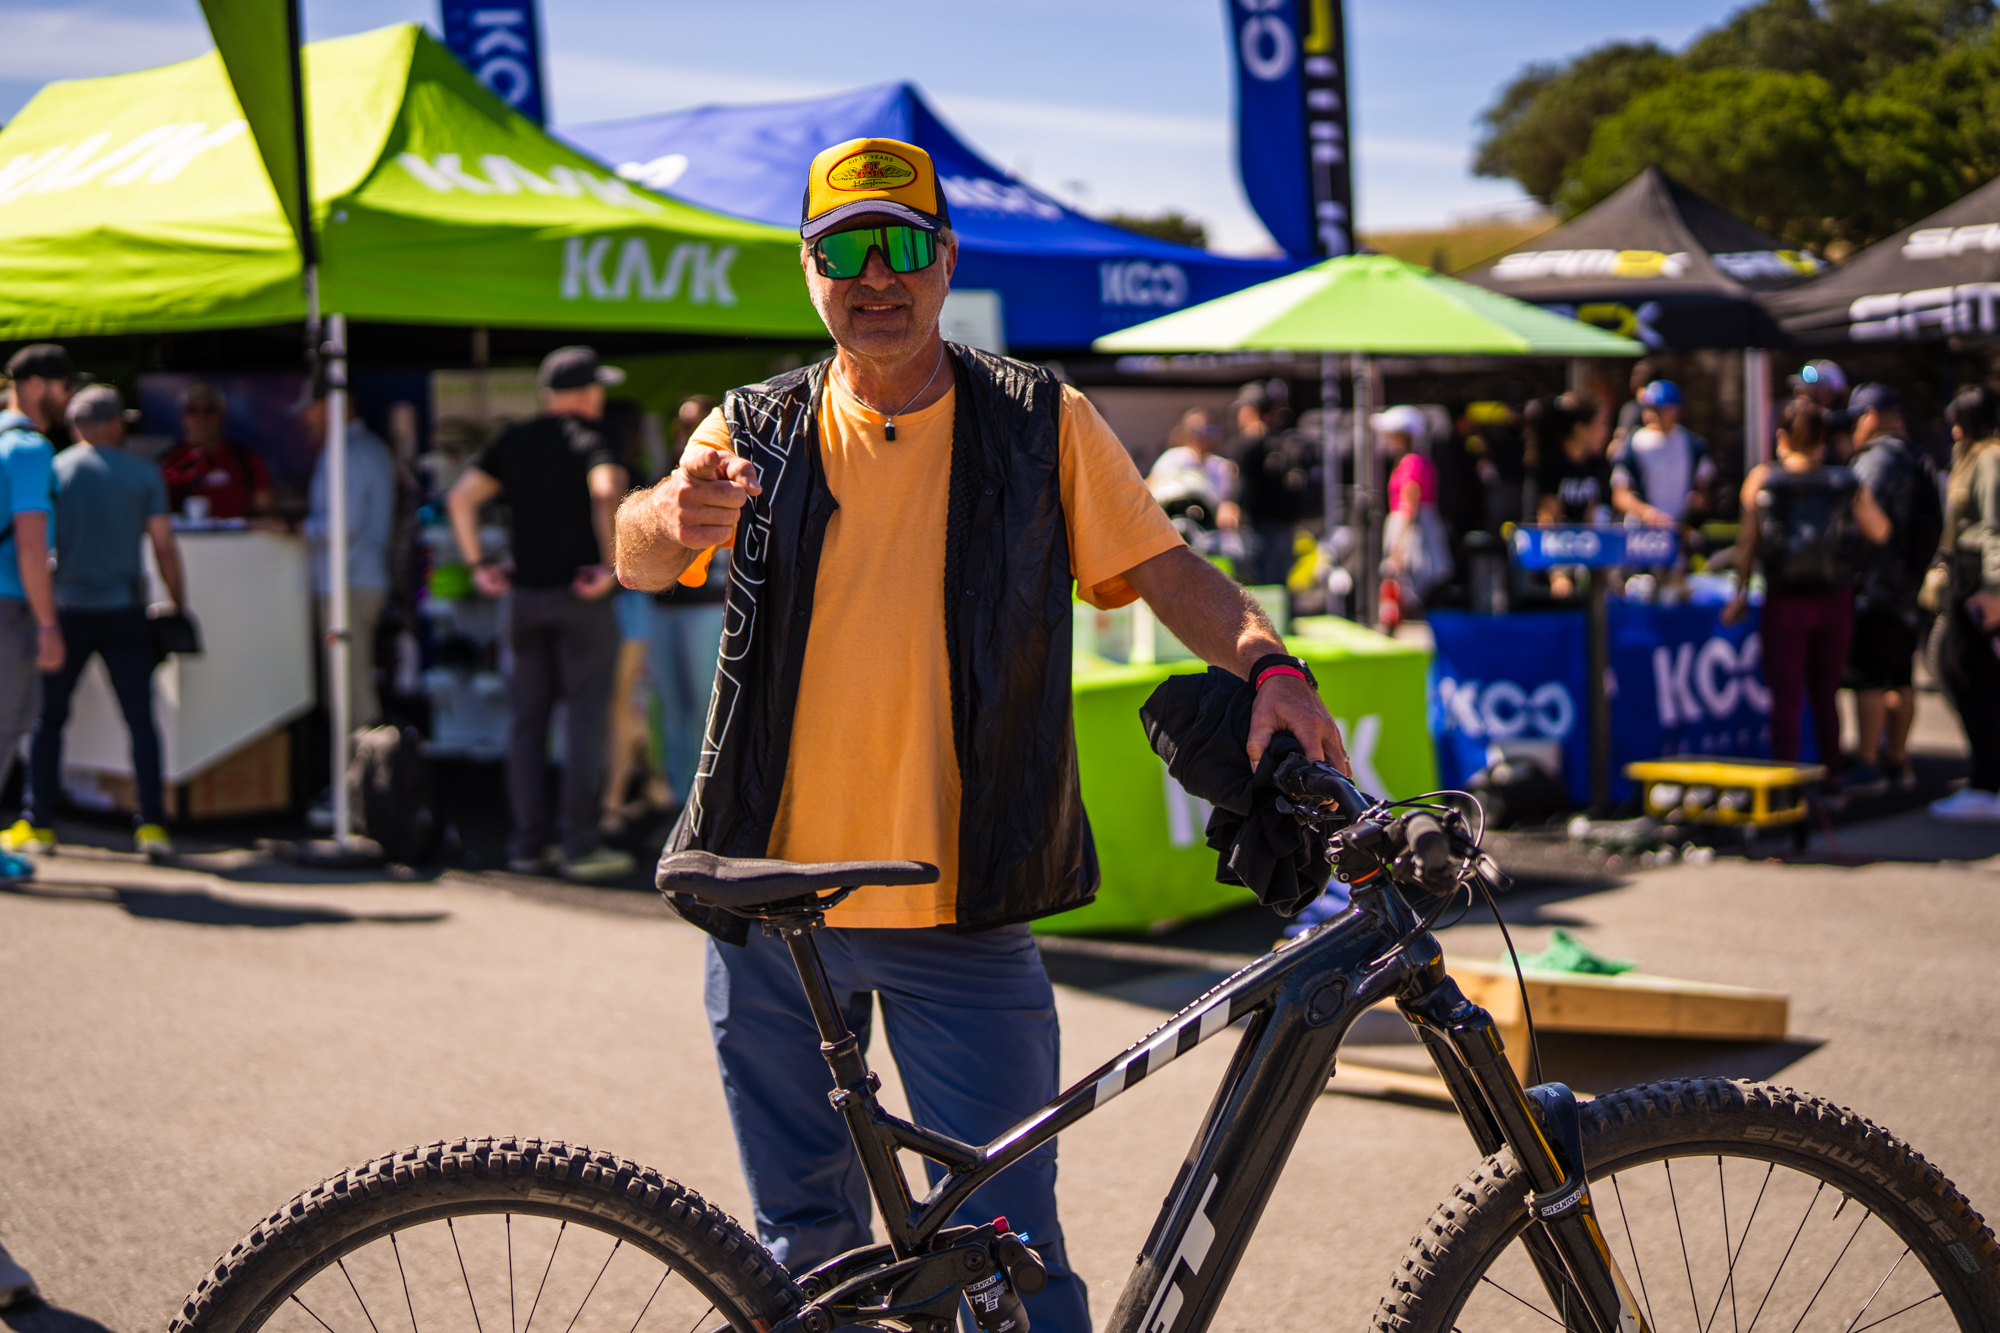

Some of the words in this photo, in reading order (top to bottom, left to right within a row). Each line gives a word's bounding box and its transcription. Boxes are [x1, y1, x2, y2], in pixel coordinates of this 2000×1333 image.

[473, 8, 530, 105] KO
[862, 160, 881, 171] GT
[869, 154, 894, 163] YEARS
[856, 169, 886, 179] BMX
[560, 235, 739, 307] KASK
[1742, 1125, 1957, 1242] SCHWALBE
[1554, 1191, 1580, 1211] SUNTOUR
